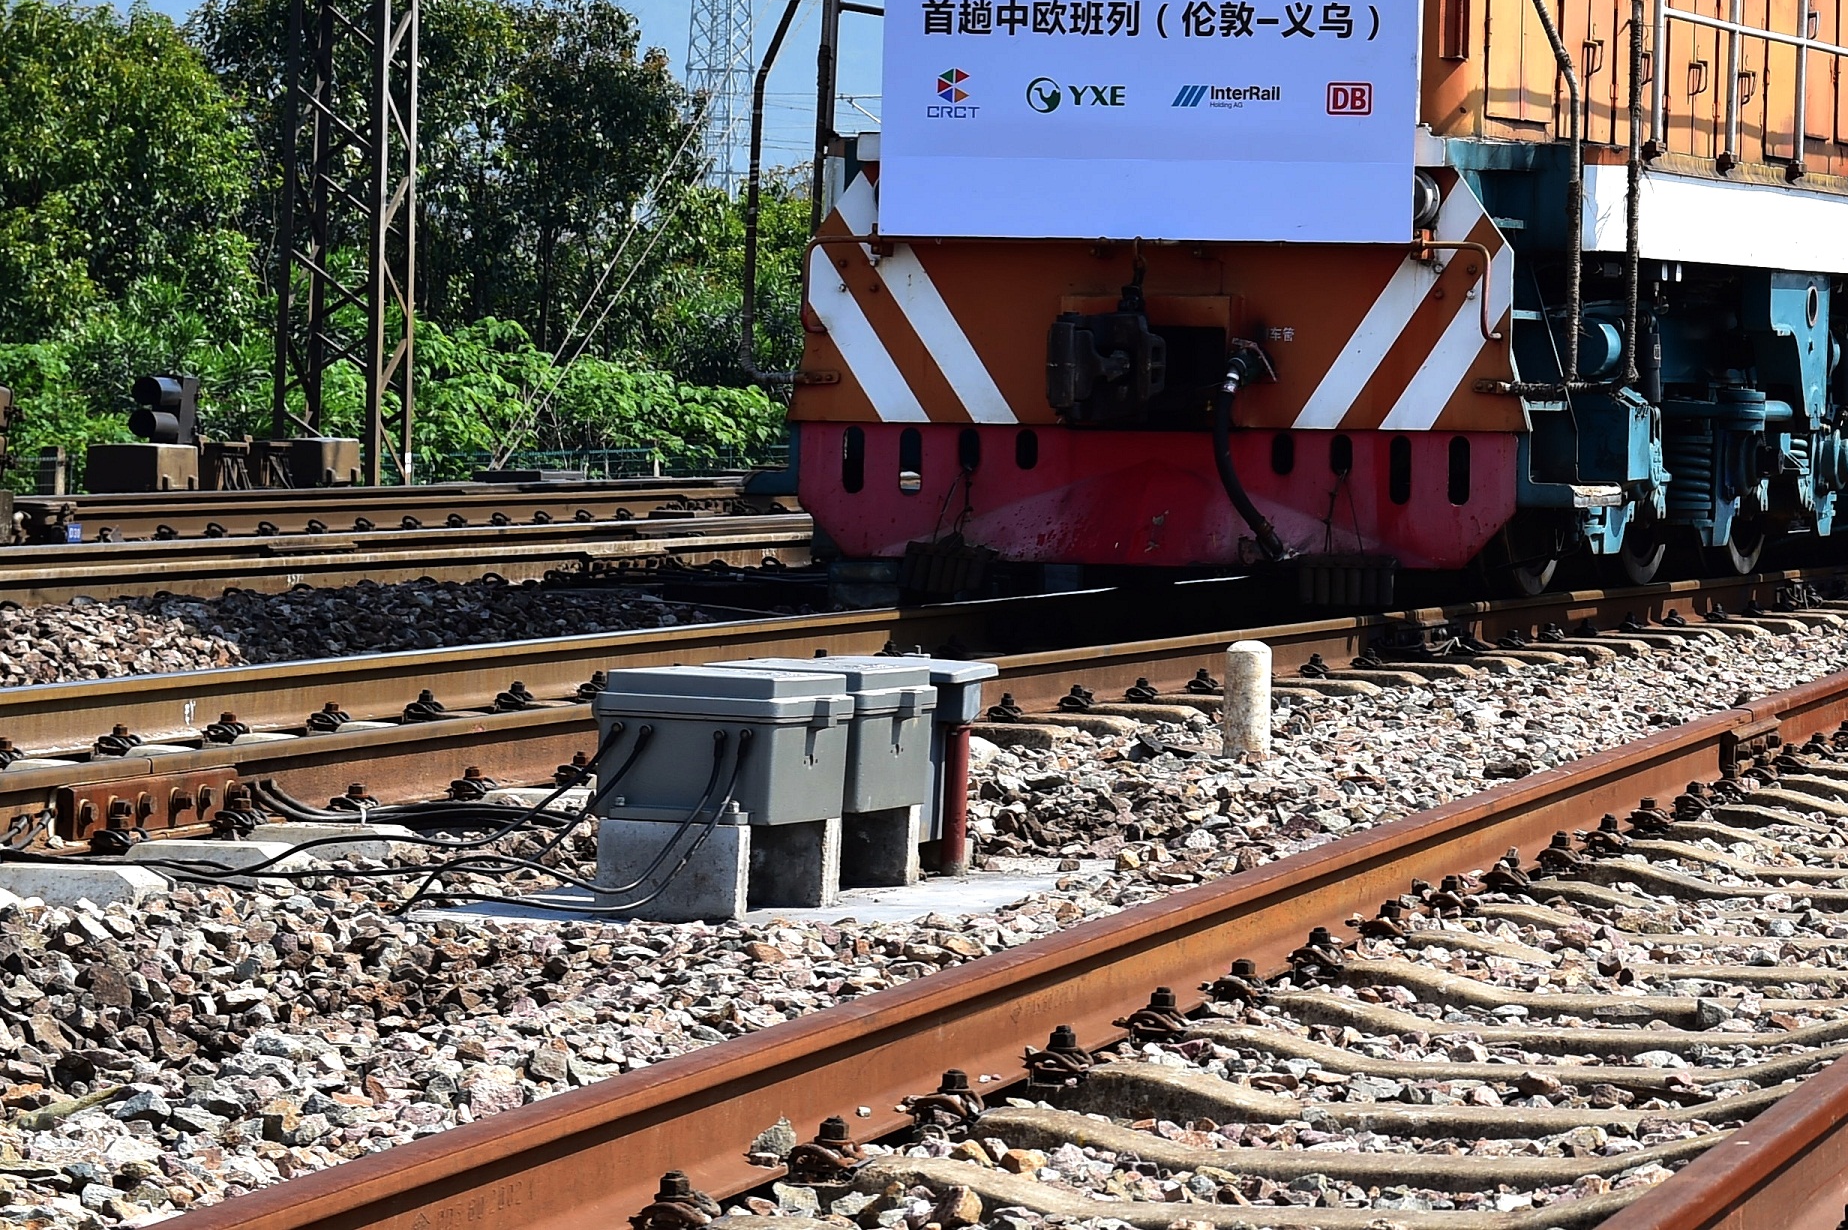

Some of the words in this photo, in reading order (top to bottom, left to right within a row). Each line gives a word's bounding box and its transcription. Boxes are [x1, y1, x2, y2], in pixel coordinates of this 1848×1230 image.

[1067, 85, 1126, 107] YXE
[1210, 85, 1281, 101] InterRail
[1331, 86, 1367, 110] DB
[926, 105, 981, 119] CRCT
[1209, 101, 1234, 110] Holding
[1234, 101, 1243, 109] AG
[1266, 327, 1295, 342] 车管
